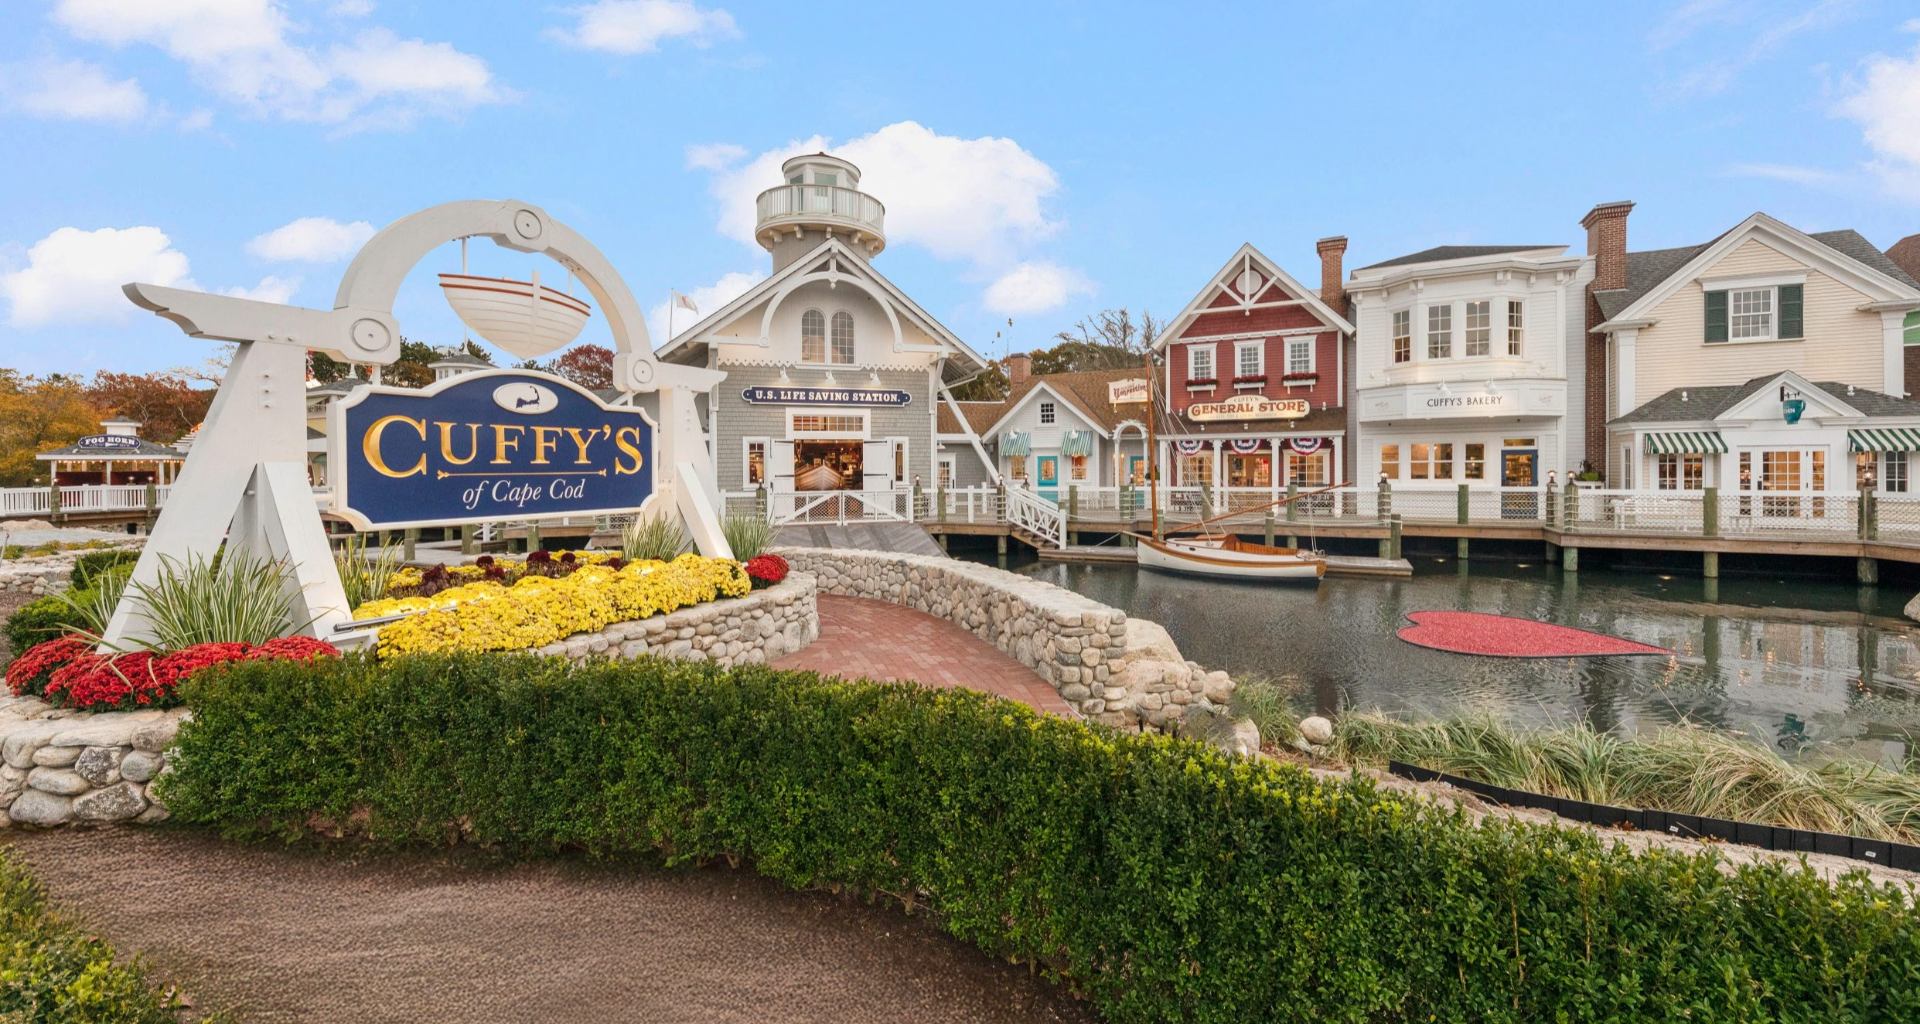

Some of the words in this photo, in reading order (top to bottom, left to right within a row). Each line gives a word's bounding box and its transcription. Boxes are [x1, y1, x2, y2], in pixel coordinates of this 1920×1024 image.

[755, 390, 777, 400] U.S.
[780, 391, 806, 400] LIFE
[808, 391, 850, 401] SAVING
[852, 392, 901, 402] STATION.
[1427, 397, 1462, 407] CUFFY'S
[1466, 395, 1503, 406] BAKERY
[1191, 403, 1254, 416] GENERAL
[1258, 401, 1306, 413] STORE
[85, 437, 105, 445] FOG
[107, 436, 135, 445] HORN
[362, 414, 644, 479] CUFFY'S
[462, 480, 490, 511] of
[491, 479, 542, 508] Cape
[549, 478, 586, 500] Cod
